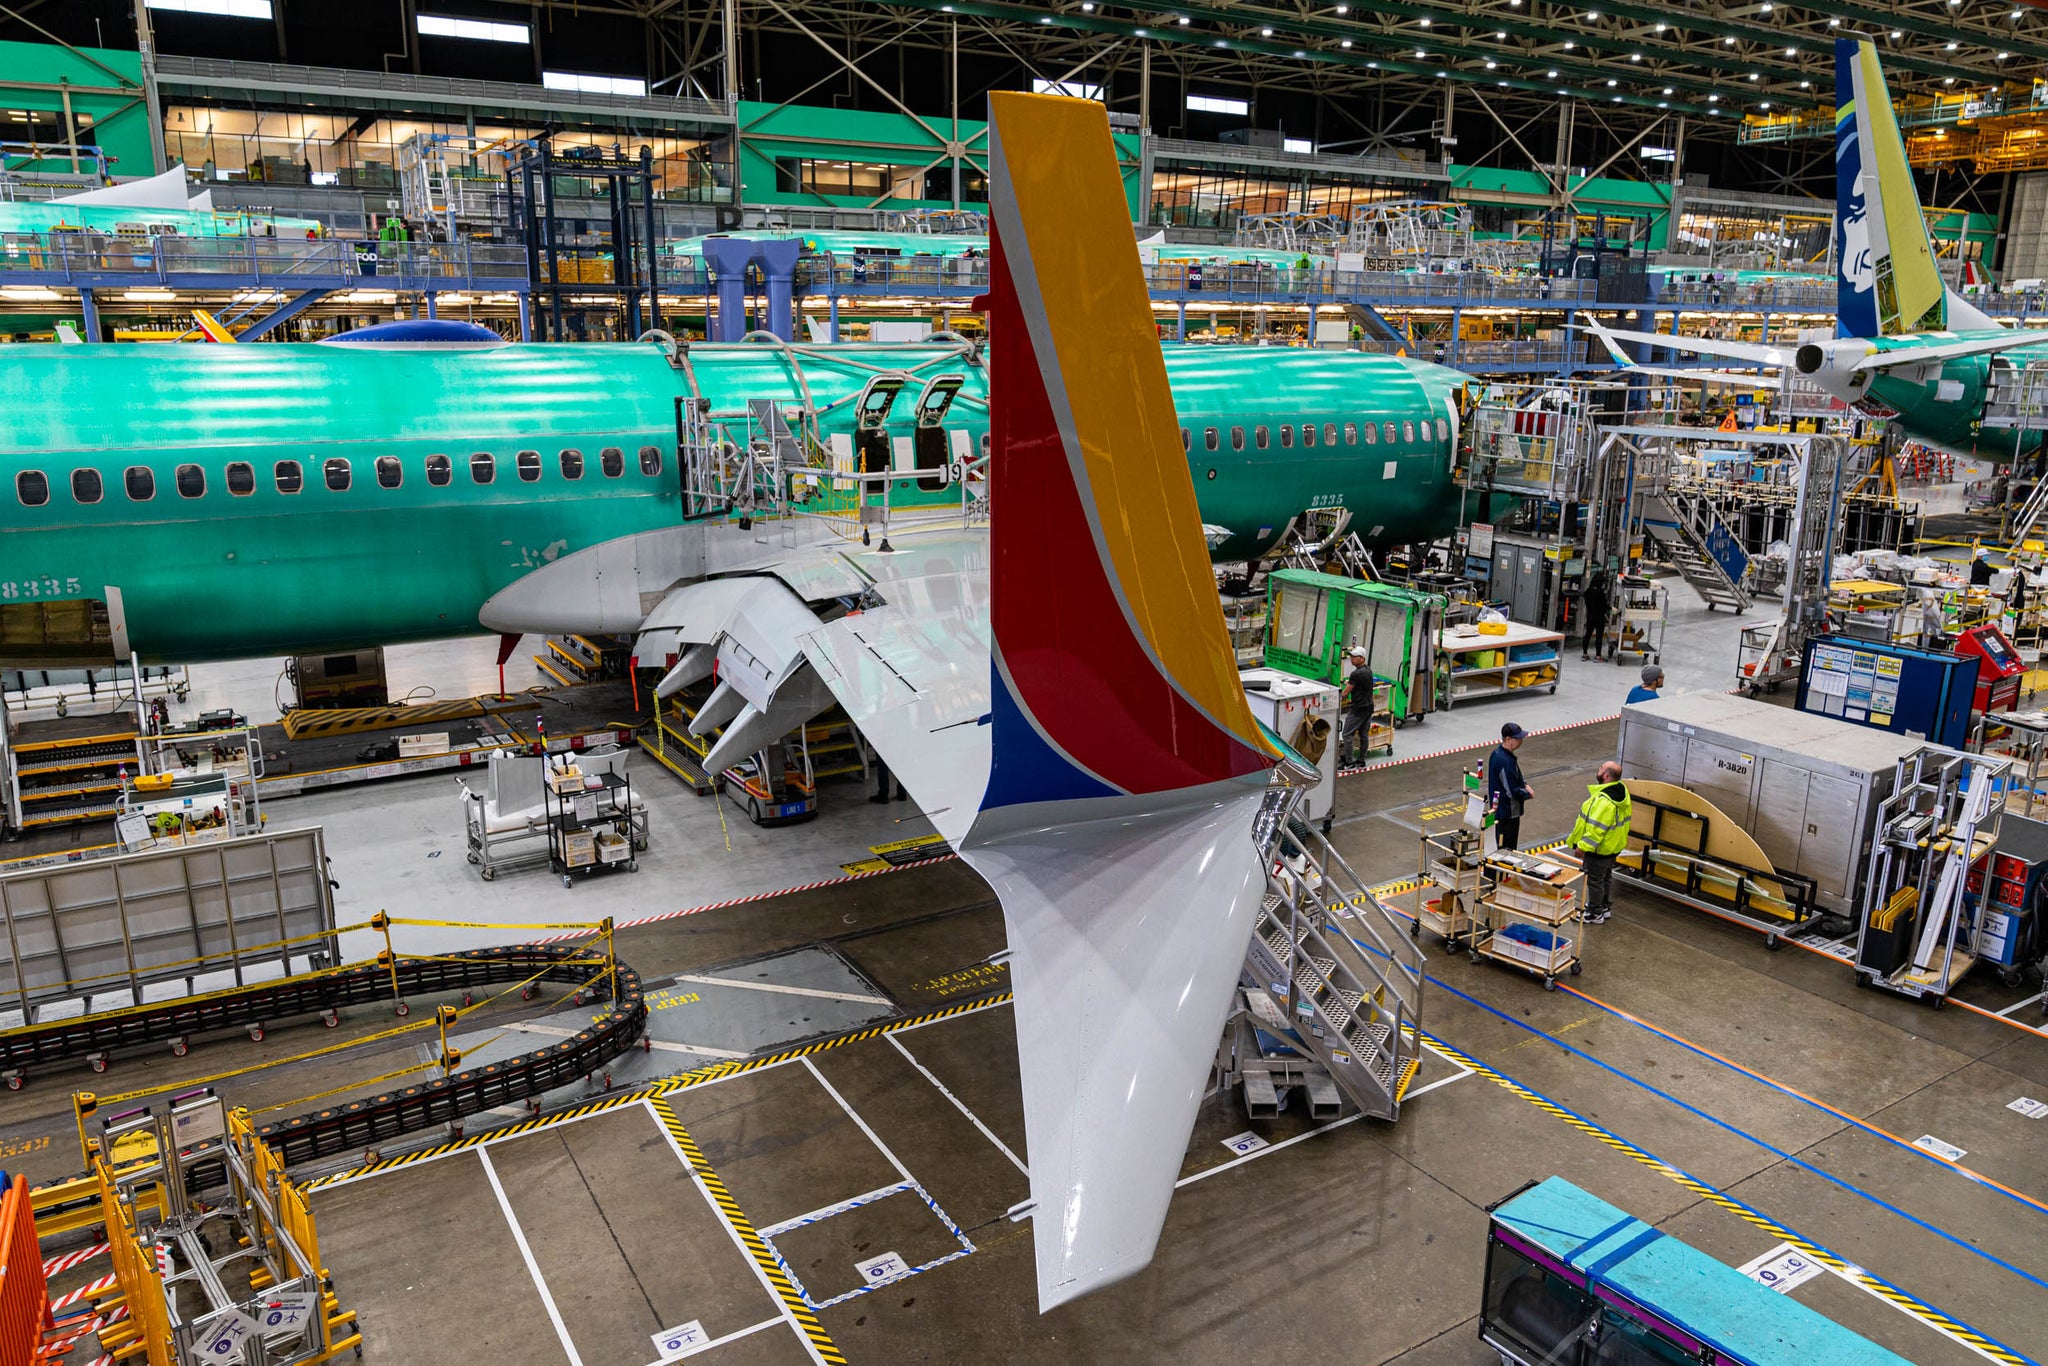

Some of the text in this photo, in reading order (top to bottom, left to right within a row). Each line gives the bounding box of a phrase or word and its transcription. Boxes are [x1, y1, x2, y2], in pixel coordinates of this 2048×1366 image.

[356, 252, 377, 261] FOD
[1724, 418, 1733, 429] 8
[1311, 493, 1344, 506] 8335
[2, 577, 81, 599] 8335
[96, 1096, 118, 1105] Caution
